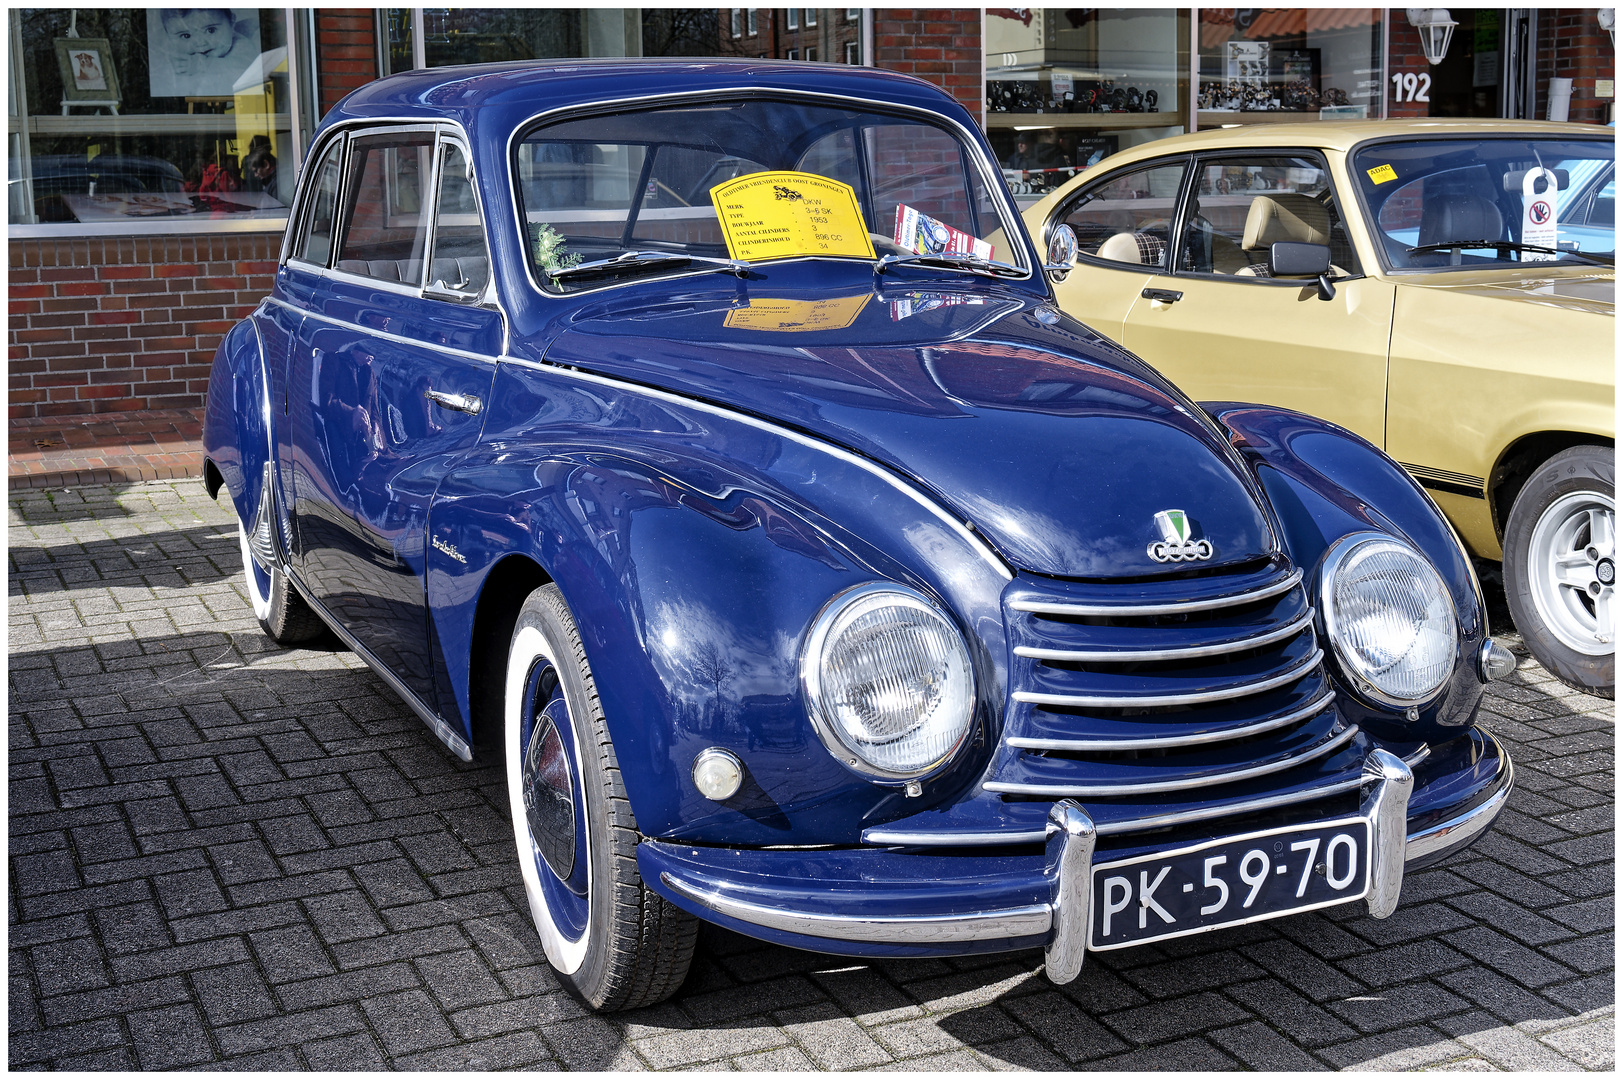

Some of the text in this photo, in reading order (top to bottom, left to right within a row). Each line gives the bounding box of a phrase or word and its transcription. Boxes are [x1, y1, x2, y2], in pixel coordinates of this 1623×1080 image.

[1391, 72, 1431, 103] 192
[1370, 165, 1391, 175] ADAC
[722, 183, 750, 198] OLDTIMER
[809, 180, 844, 194] GRONINGEN
[820, 207, 833, 215] SK
[731, 220, 764, 228] BOUWJAAR
[809, 216, 828, 224] 1953
[758, 227, 790, 235] CILINDERS
[814, 233, 830, 241] 896
[1102, 833, 1358, 937] PK-59-70
